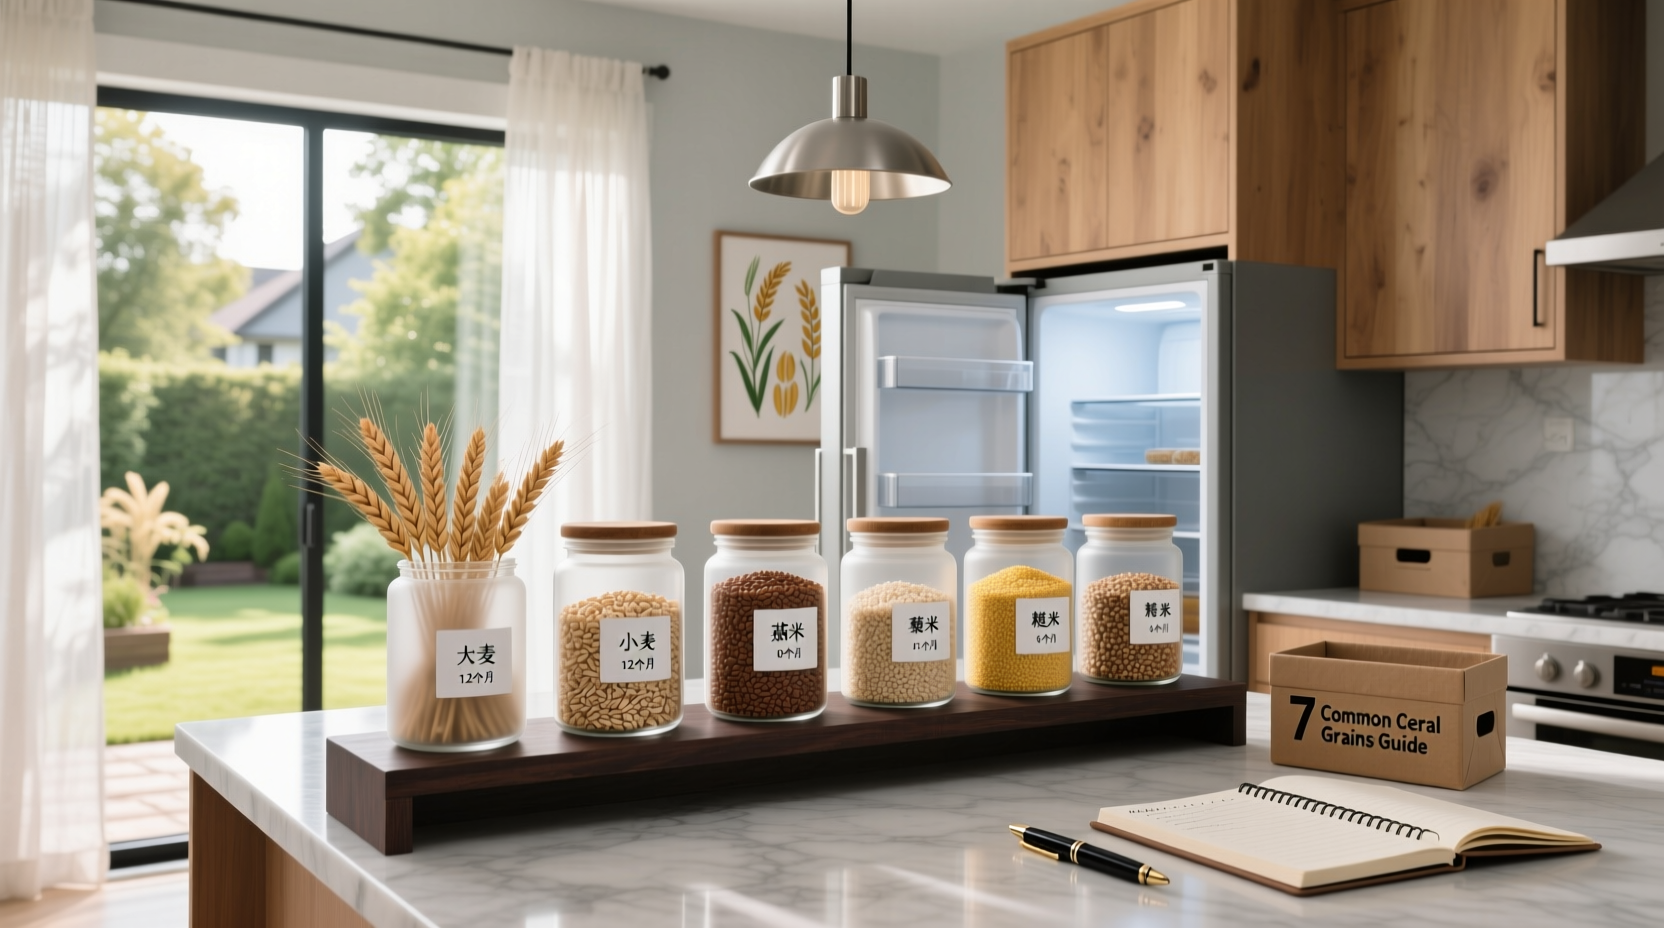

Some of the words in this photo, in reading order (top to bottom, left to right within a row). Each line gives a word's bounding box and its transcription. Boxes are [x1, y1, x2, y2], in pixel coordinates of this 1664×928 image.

[619, 631, 656, 652] 小麦
[457, 643, 496, 666] 大麦
[622, 657, 654, 671] 12个月
[459, 670, 493, 684] 12个月
[1289, 695, 1316, 741] 7
[1321, 705, 1391, 728] Common
[1396, 713, 1441, 734] Ceral
[1321, 726, 1375, 748] Grains
[1378, 733, 1428, 754] Guide
